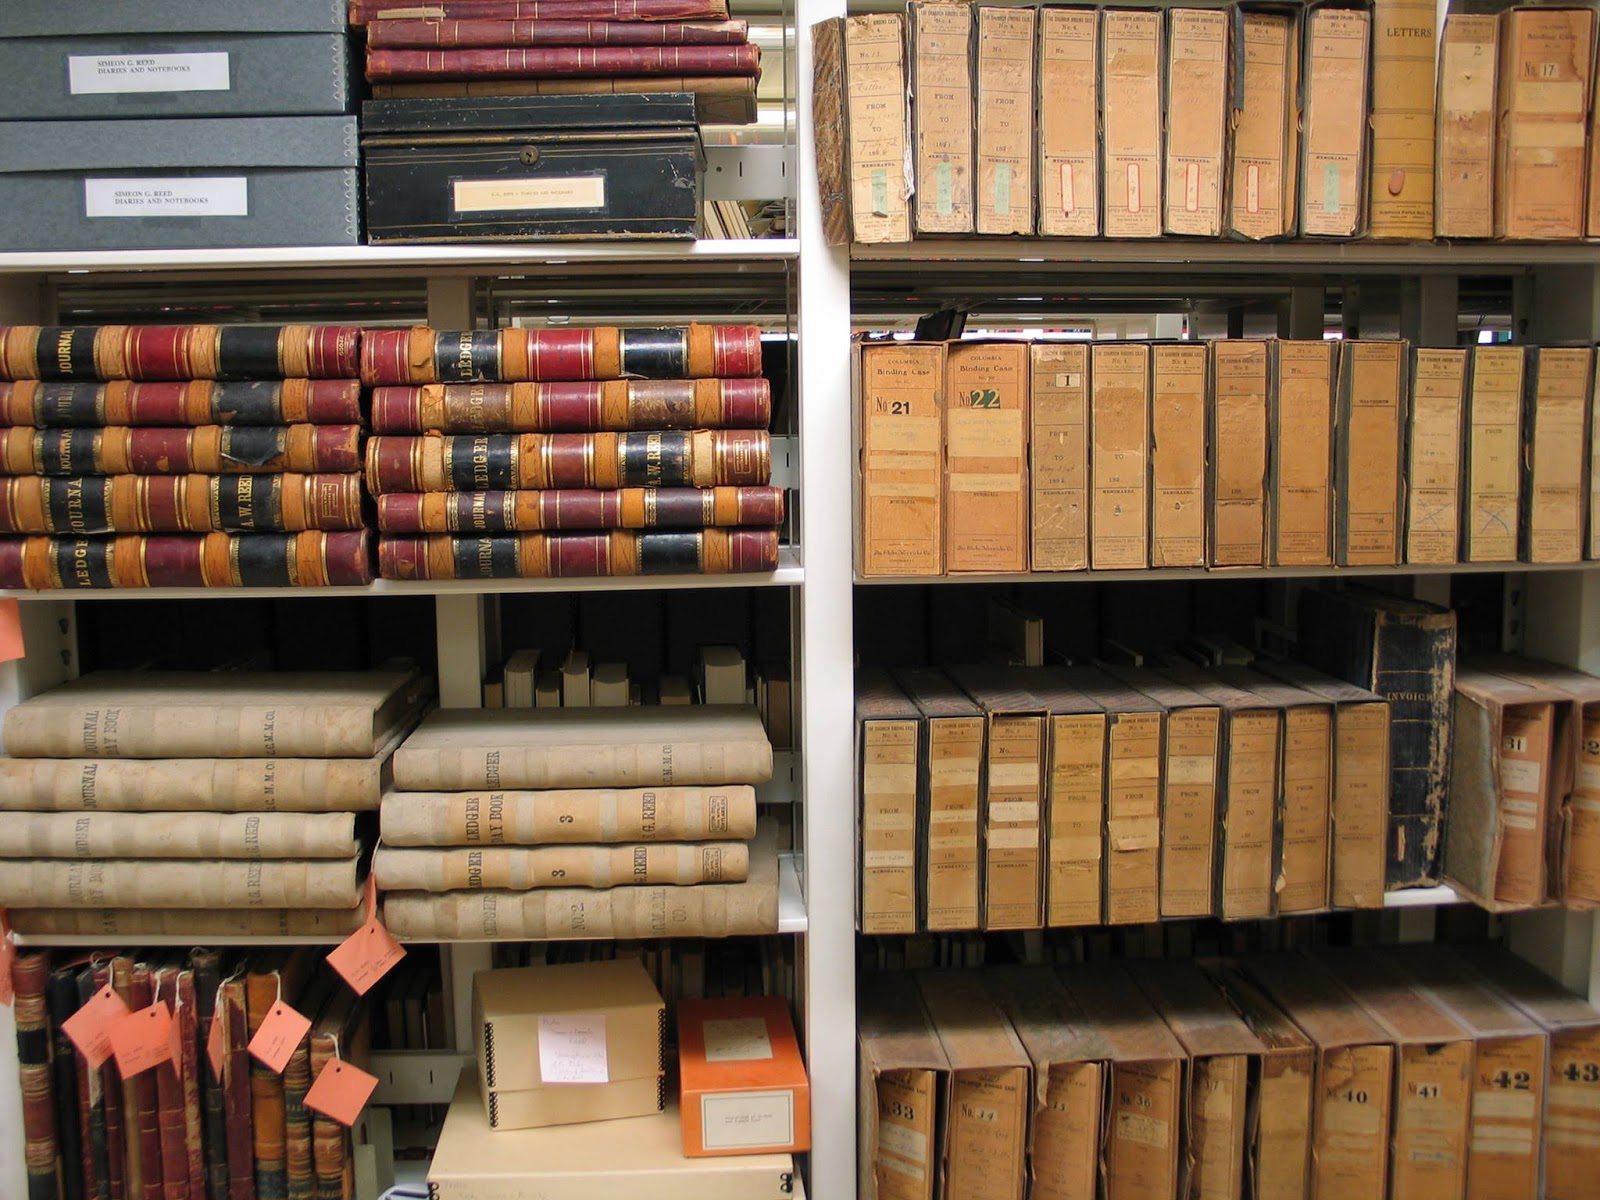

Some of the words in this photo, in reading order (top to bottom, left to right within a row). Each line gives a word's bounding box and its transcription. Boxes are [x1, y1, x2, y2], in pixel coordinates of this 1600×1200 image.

[1387, 28, 1432, 38] LETTERS
[1474, 46, 1482, 56] 2
[1525, 63, 1538, 76] No.
[1542, 64, 1555, 76] 17
[58, 329, 75, 374] JOURNAL
[960, 365, 990, 373] Binding
[1064, 374, 1071, 386] 1
[892, 401, 910, 415] 21
[971, 389, 1000, 409] 22
[473, 437, 489, 489] LEDGER
[647, 462, 661, 475] W.
[238, 474, 253, 501] REED
[67, 477, 85, 534] JOURNA
[239, 502, 253, 517] W.
[473, 491, 487, 530] JOURNAL
[239, 517, 255, 528] A.
[75, 539, 92, 586] LEDGE
[480, 537, 493, 578] JOURNA
[105, 709, 121, 734] BOOK
[83, 710, 100, 755] JOURNAL
[1506, 737, 1522, 750] 31
[486, 750, 500, 789] LEDGER
[82, 763, 98, 808] JOURNAL
[489, 793, 505, 822] BOOK
[641, 792, 656, 820] REED
[465, 797, 480, 841] LEDGER
[559, 814, 574, 824] 3
[244, 816, 260, 844] REED
[490, 824, 505, 844] DAY
[634, 846, 648, 872] REED
[90, 862, 105, 884] BOO
[1493, 1070, 1530, 1090] 42
[1562, 1062, 1599, 1082] 43
[1135, 1096, 1151, 1107] 36
[1418, 1086, 1438, 1098] 41
[891, 1101, 914, 1120] 33
[961, 1103, 974, 1118] No.
